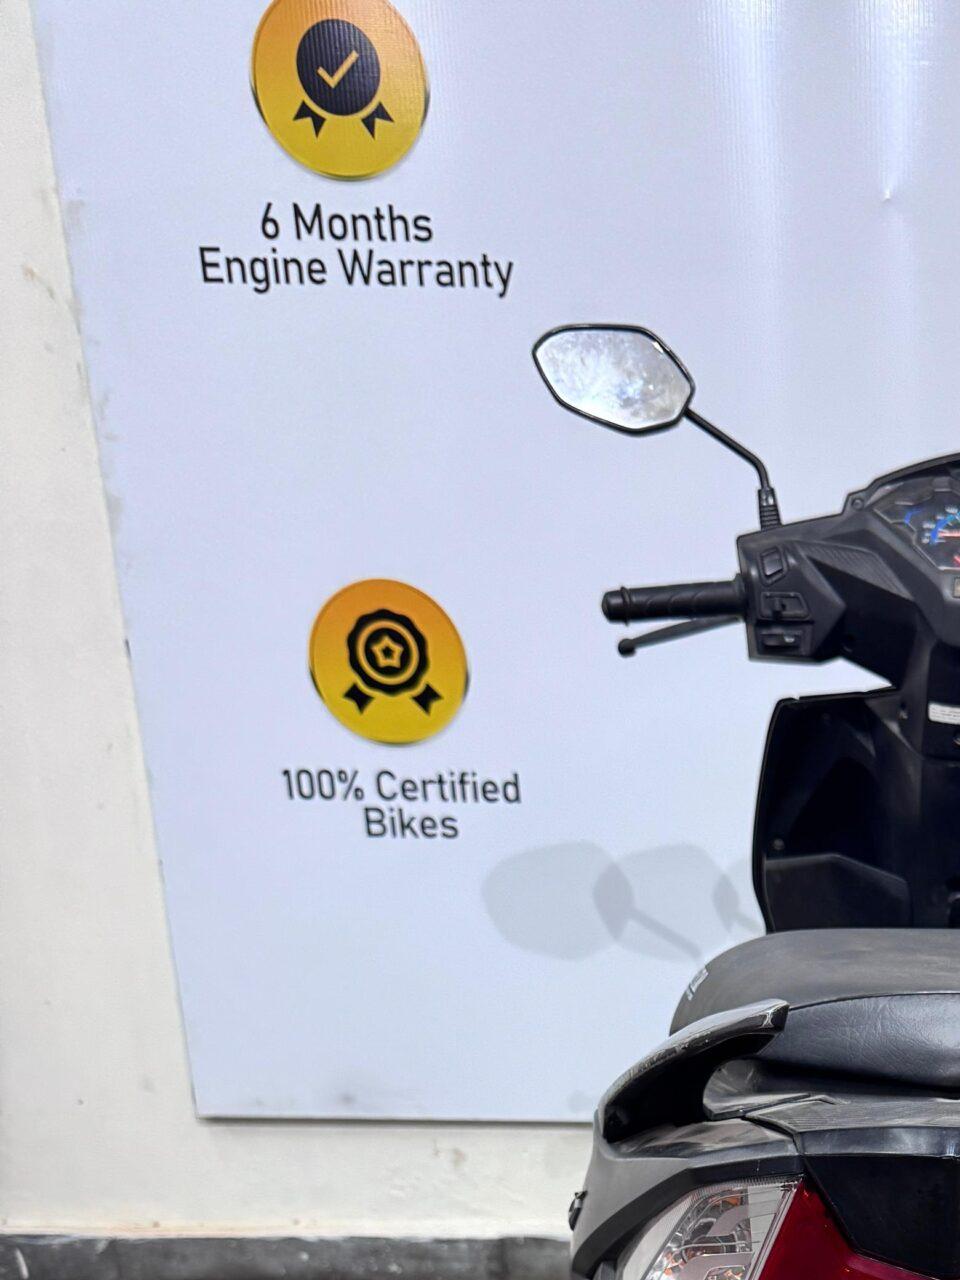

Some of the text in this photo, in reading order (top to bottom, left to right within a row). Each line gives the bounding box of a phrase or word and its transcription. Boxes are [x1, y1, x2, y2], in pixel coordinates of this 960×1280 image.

[262, 202, 433, 243] 6 Months
[198, 246, 514, 299] Engine Warranty
[281, 768, 522, 804] 100% Certified
[363, 806, 460, 840] Bikes
